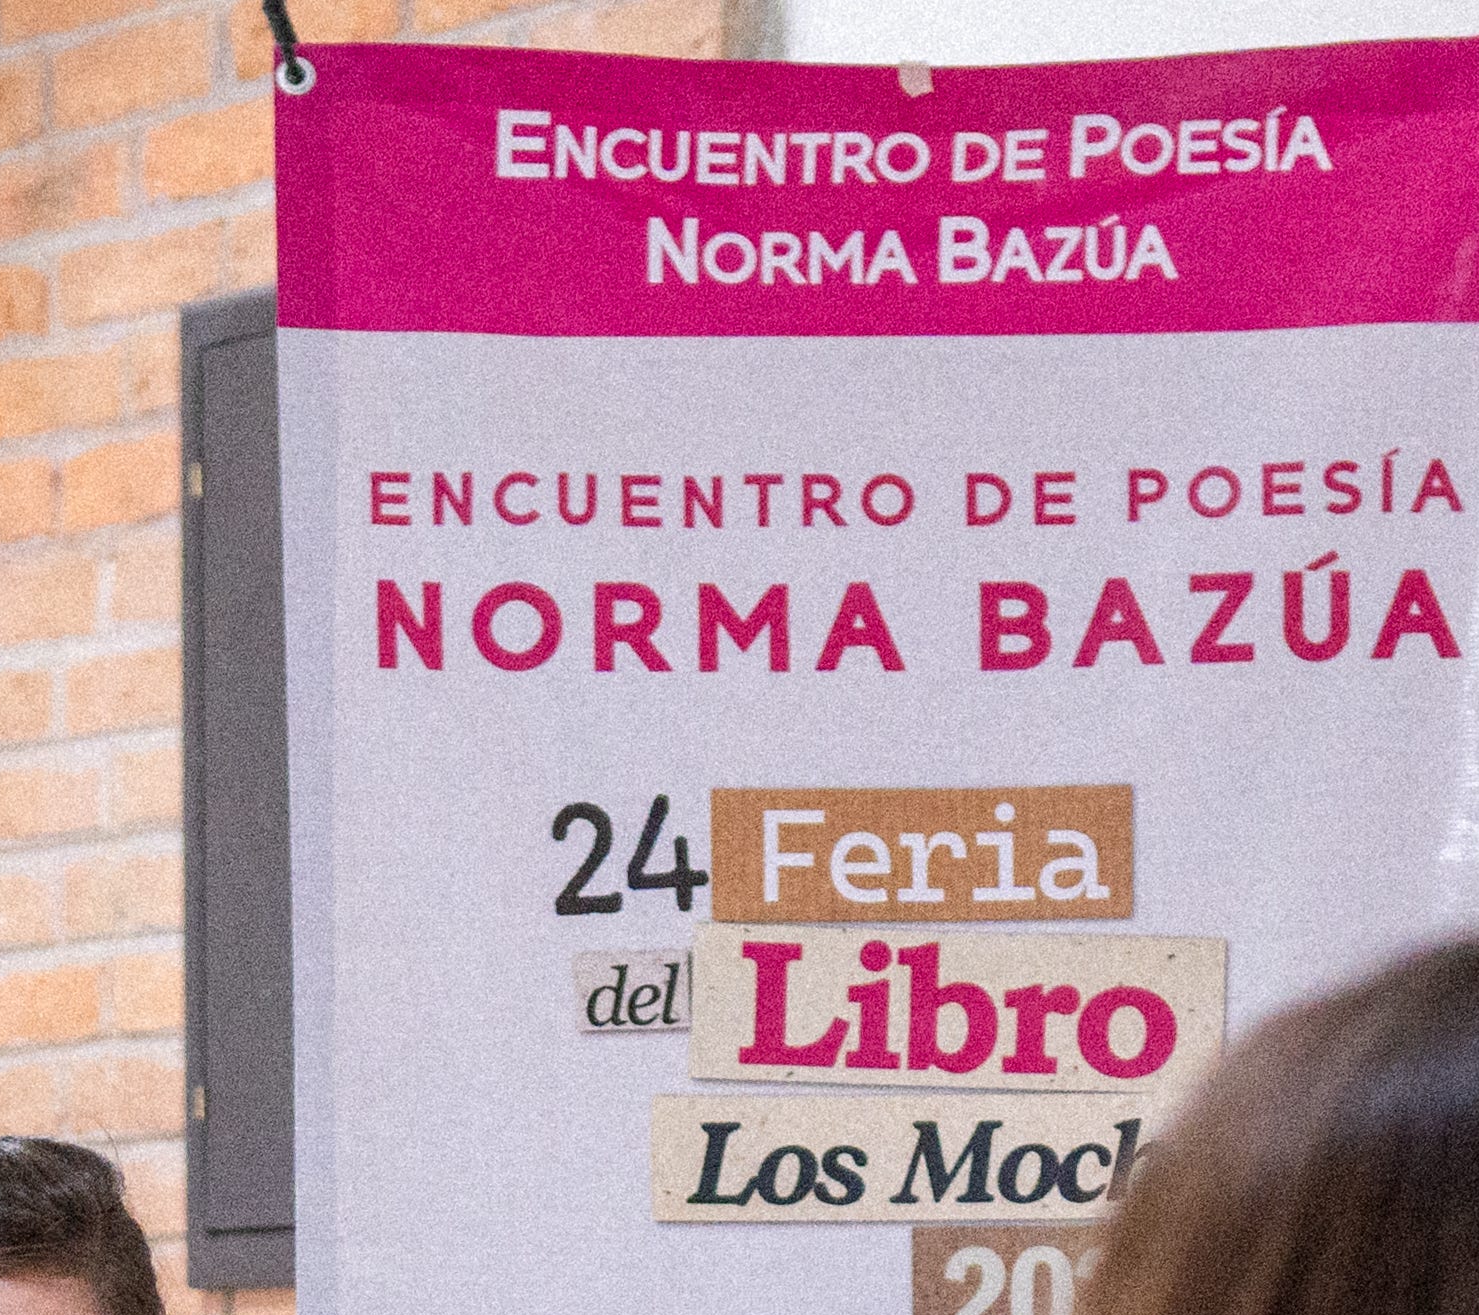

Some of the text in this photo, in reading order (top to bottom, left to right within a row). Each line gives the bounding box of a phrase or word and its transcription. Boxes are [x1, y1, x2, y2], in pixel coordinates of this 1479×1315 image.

[495, 106, 1333, 186] ENCUENTRO DE POESÍA
[646, 213, 1180, 286] NORMA BAZÚA
[369, 447, 1465, 530] ENCUENTRO DE POESÍA
[375, 550, 1462, 673] NORMA BAZÚA
[552, 793, 1112, 917] 24 Feria
[585, 939, 1179, 1079] del Libro
[688, 1120, 870, 1208] Los
